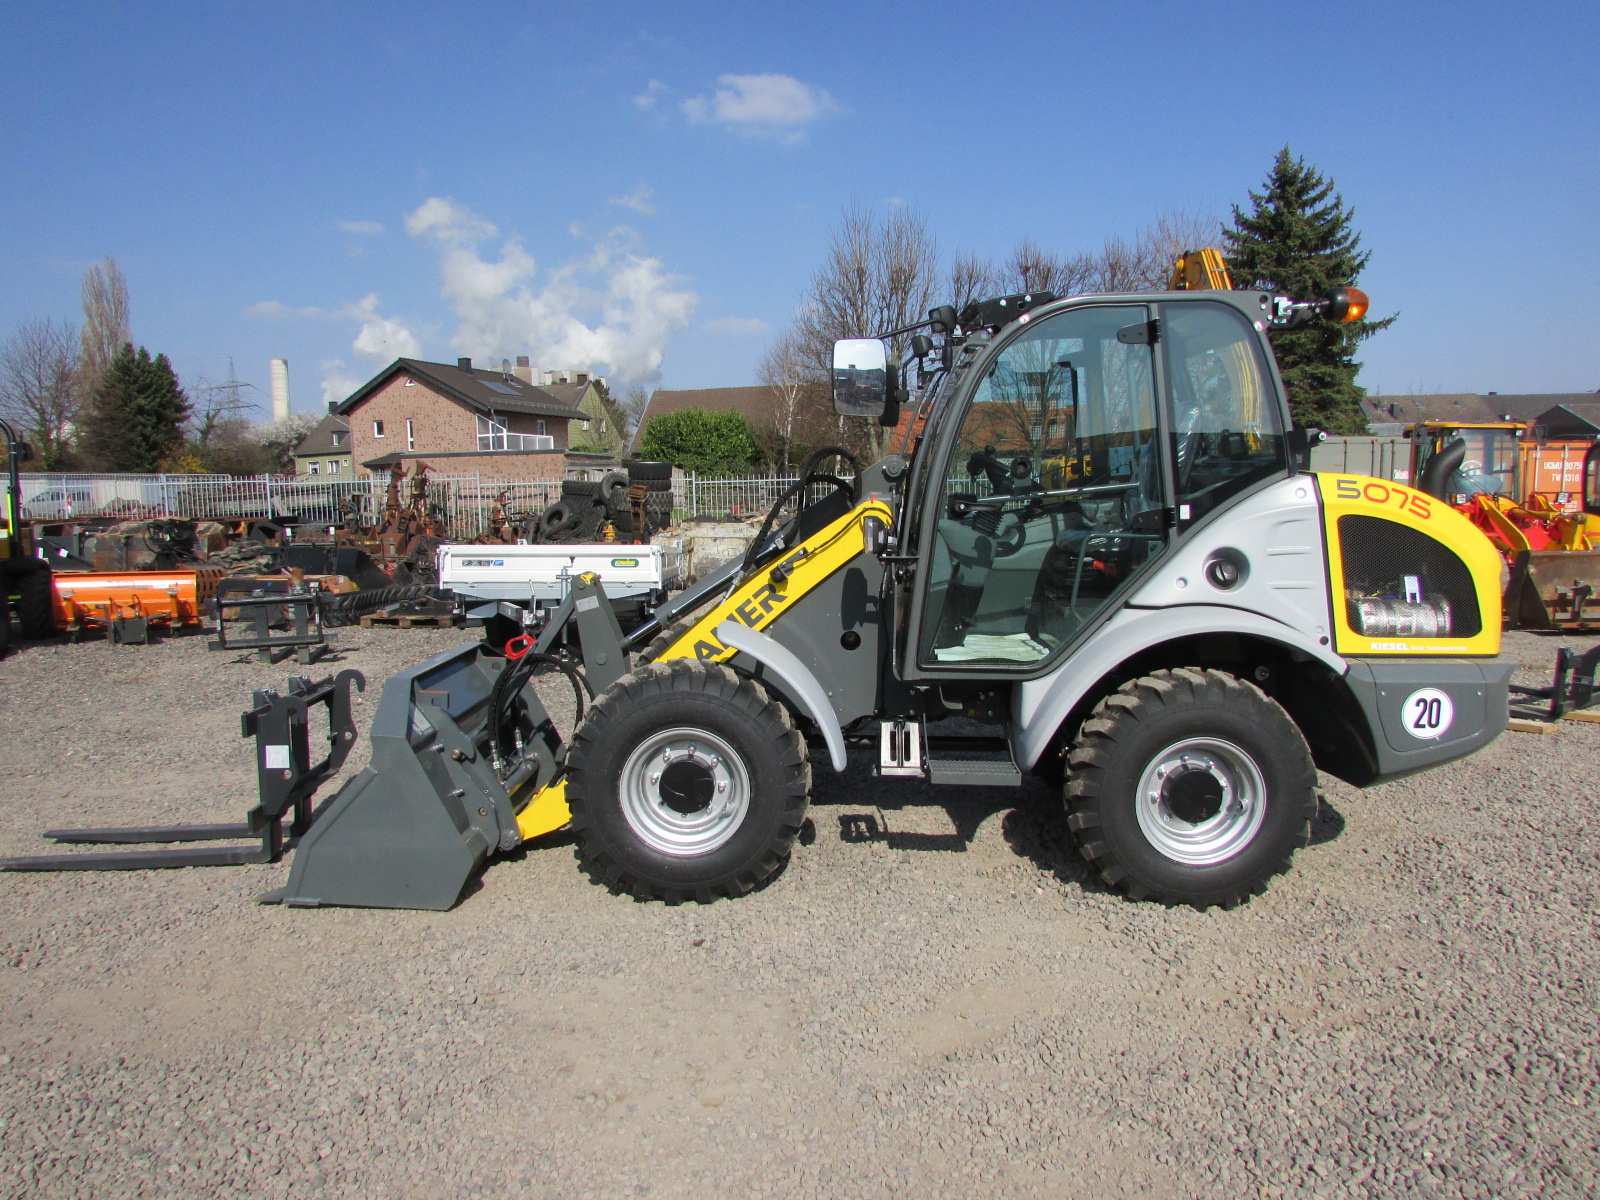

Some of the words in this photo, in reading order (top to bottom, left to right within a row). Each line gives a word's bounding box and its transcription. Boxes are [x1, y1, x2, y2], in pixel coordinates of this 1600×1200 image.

[1336, 479, 1431, 520] 5075
[1370, 642, 1409, 651] KIESEL
[1413, 697, 1442, 729] 20
